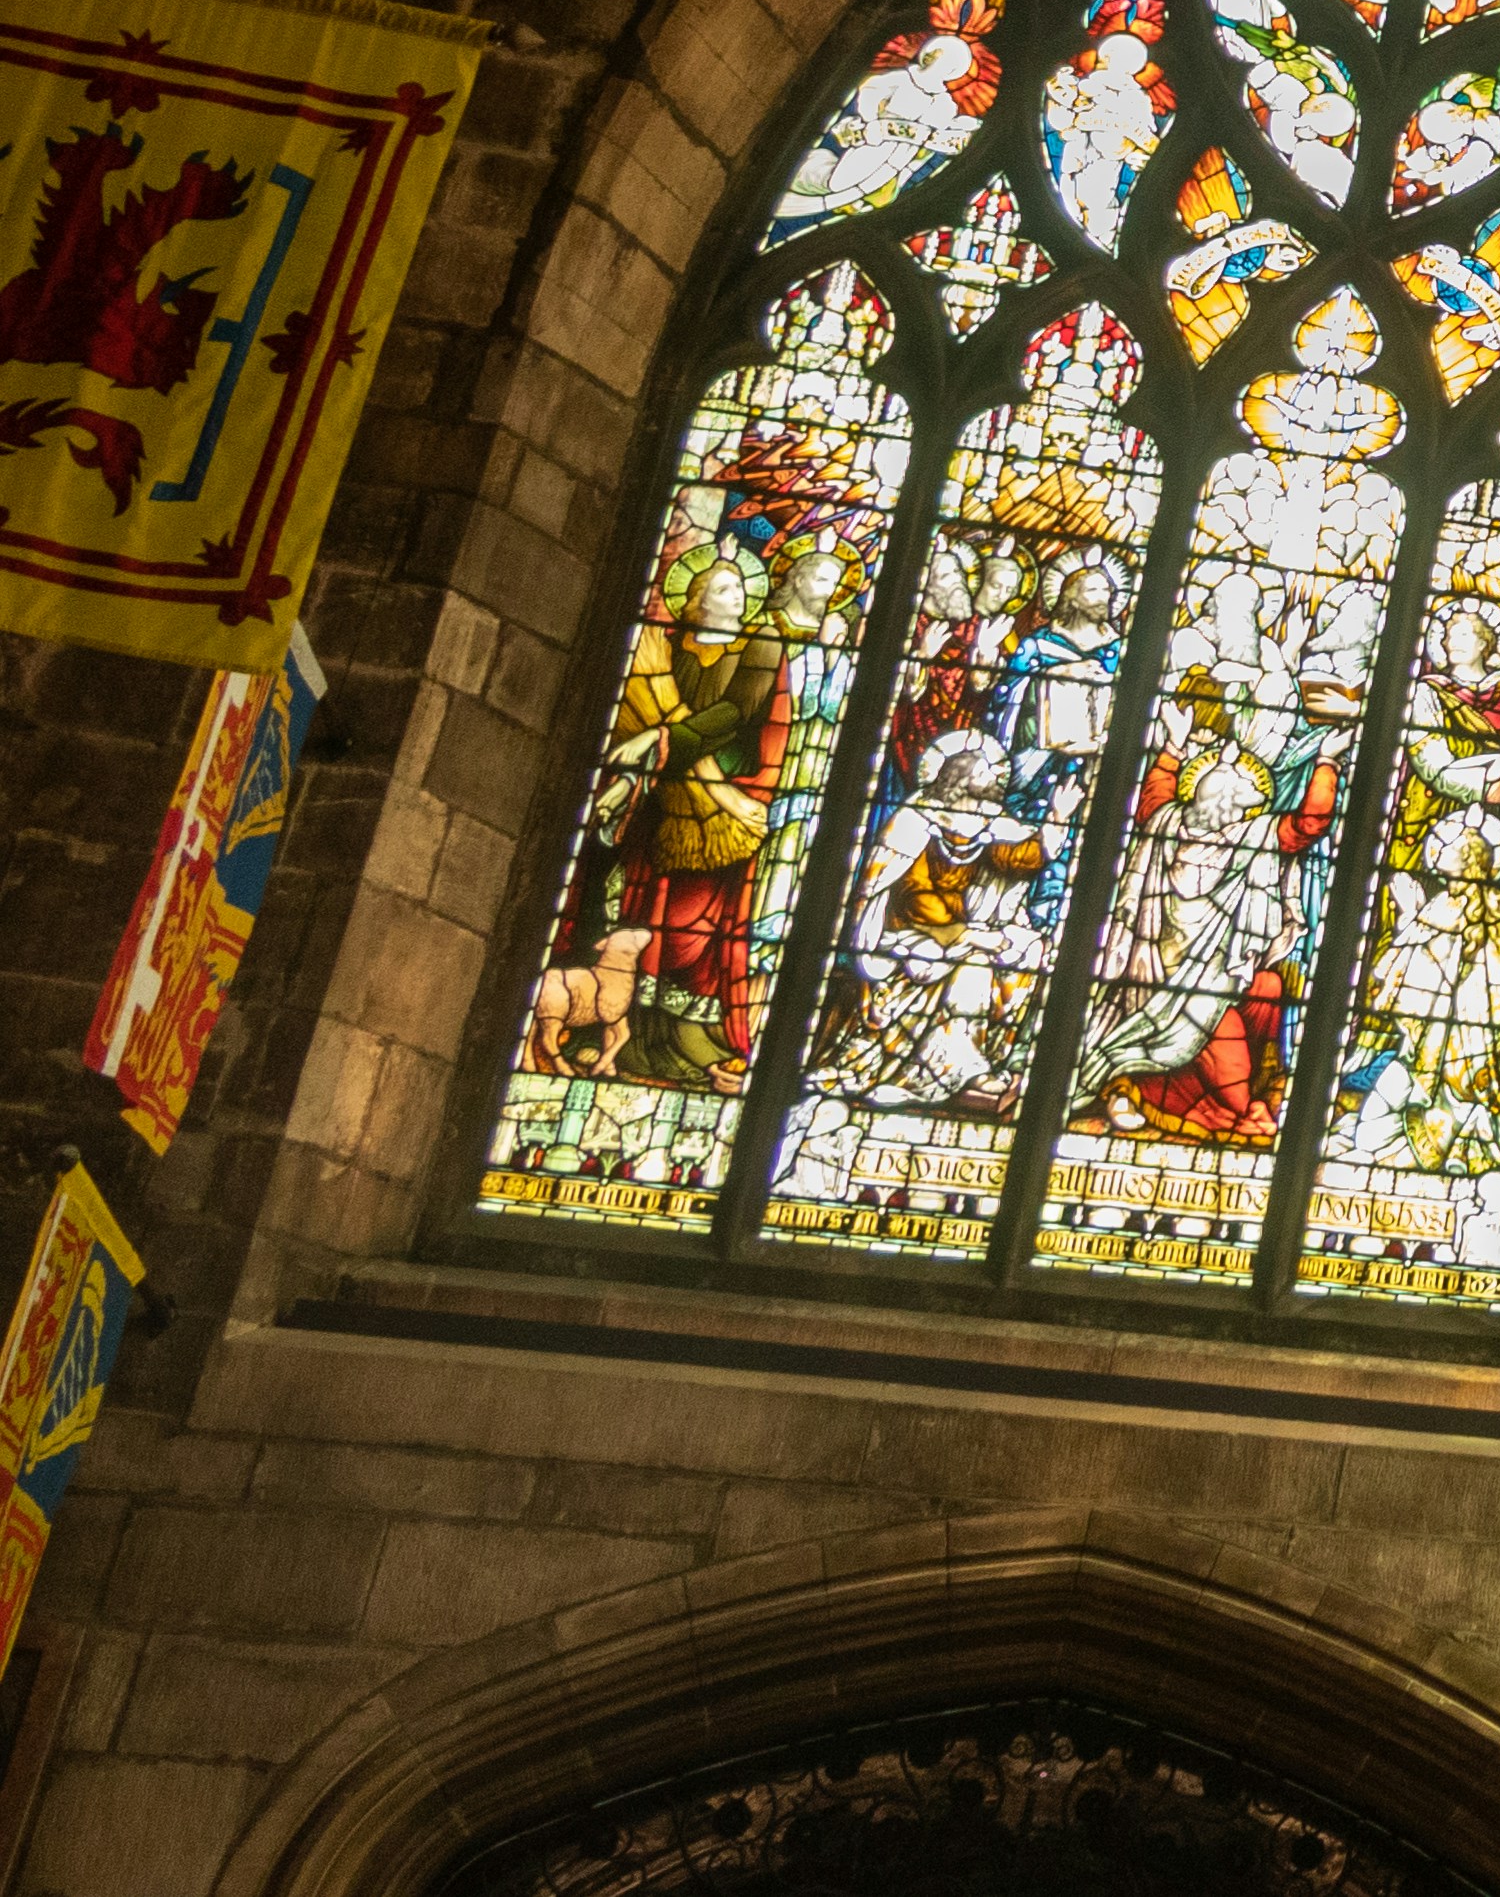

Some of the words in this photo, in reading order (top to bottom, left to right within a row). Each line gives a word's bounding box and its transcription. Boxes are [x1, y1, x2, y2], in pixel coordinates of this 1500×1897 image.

[671, 1191, 692, 1214] of
[764, 1203, 844, 1230] James
[855, 1148, 931, 1181] They
[936, 1161, 1005, 1185] were
[1051, 1166, 1083, 1192] all
[1161, 1178, 1219, 1207] with
[1227, 1183, 1268, 1211] the
[1375, 1200, 1449, 1232] Ghost
